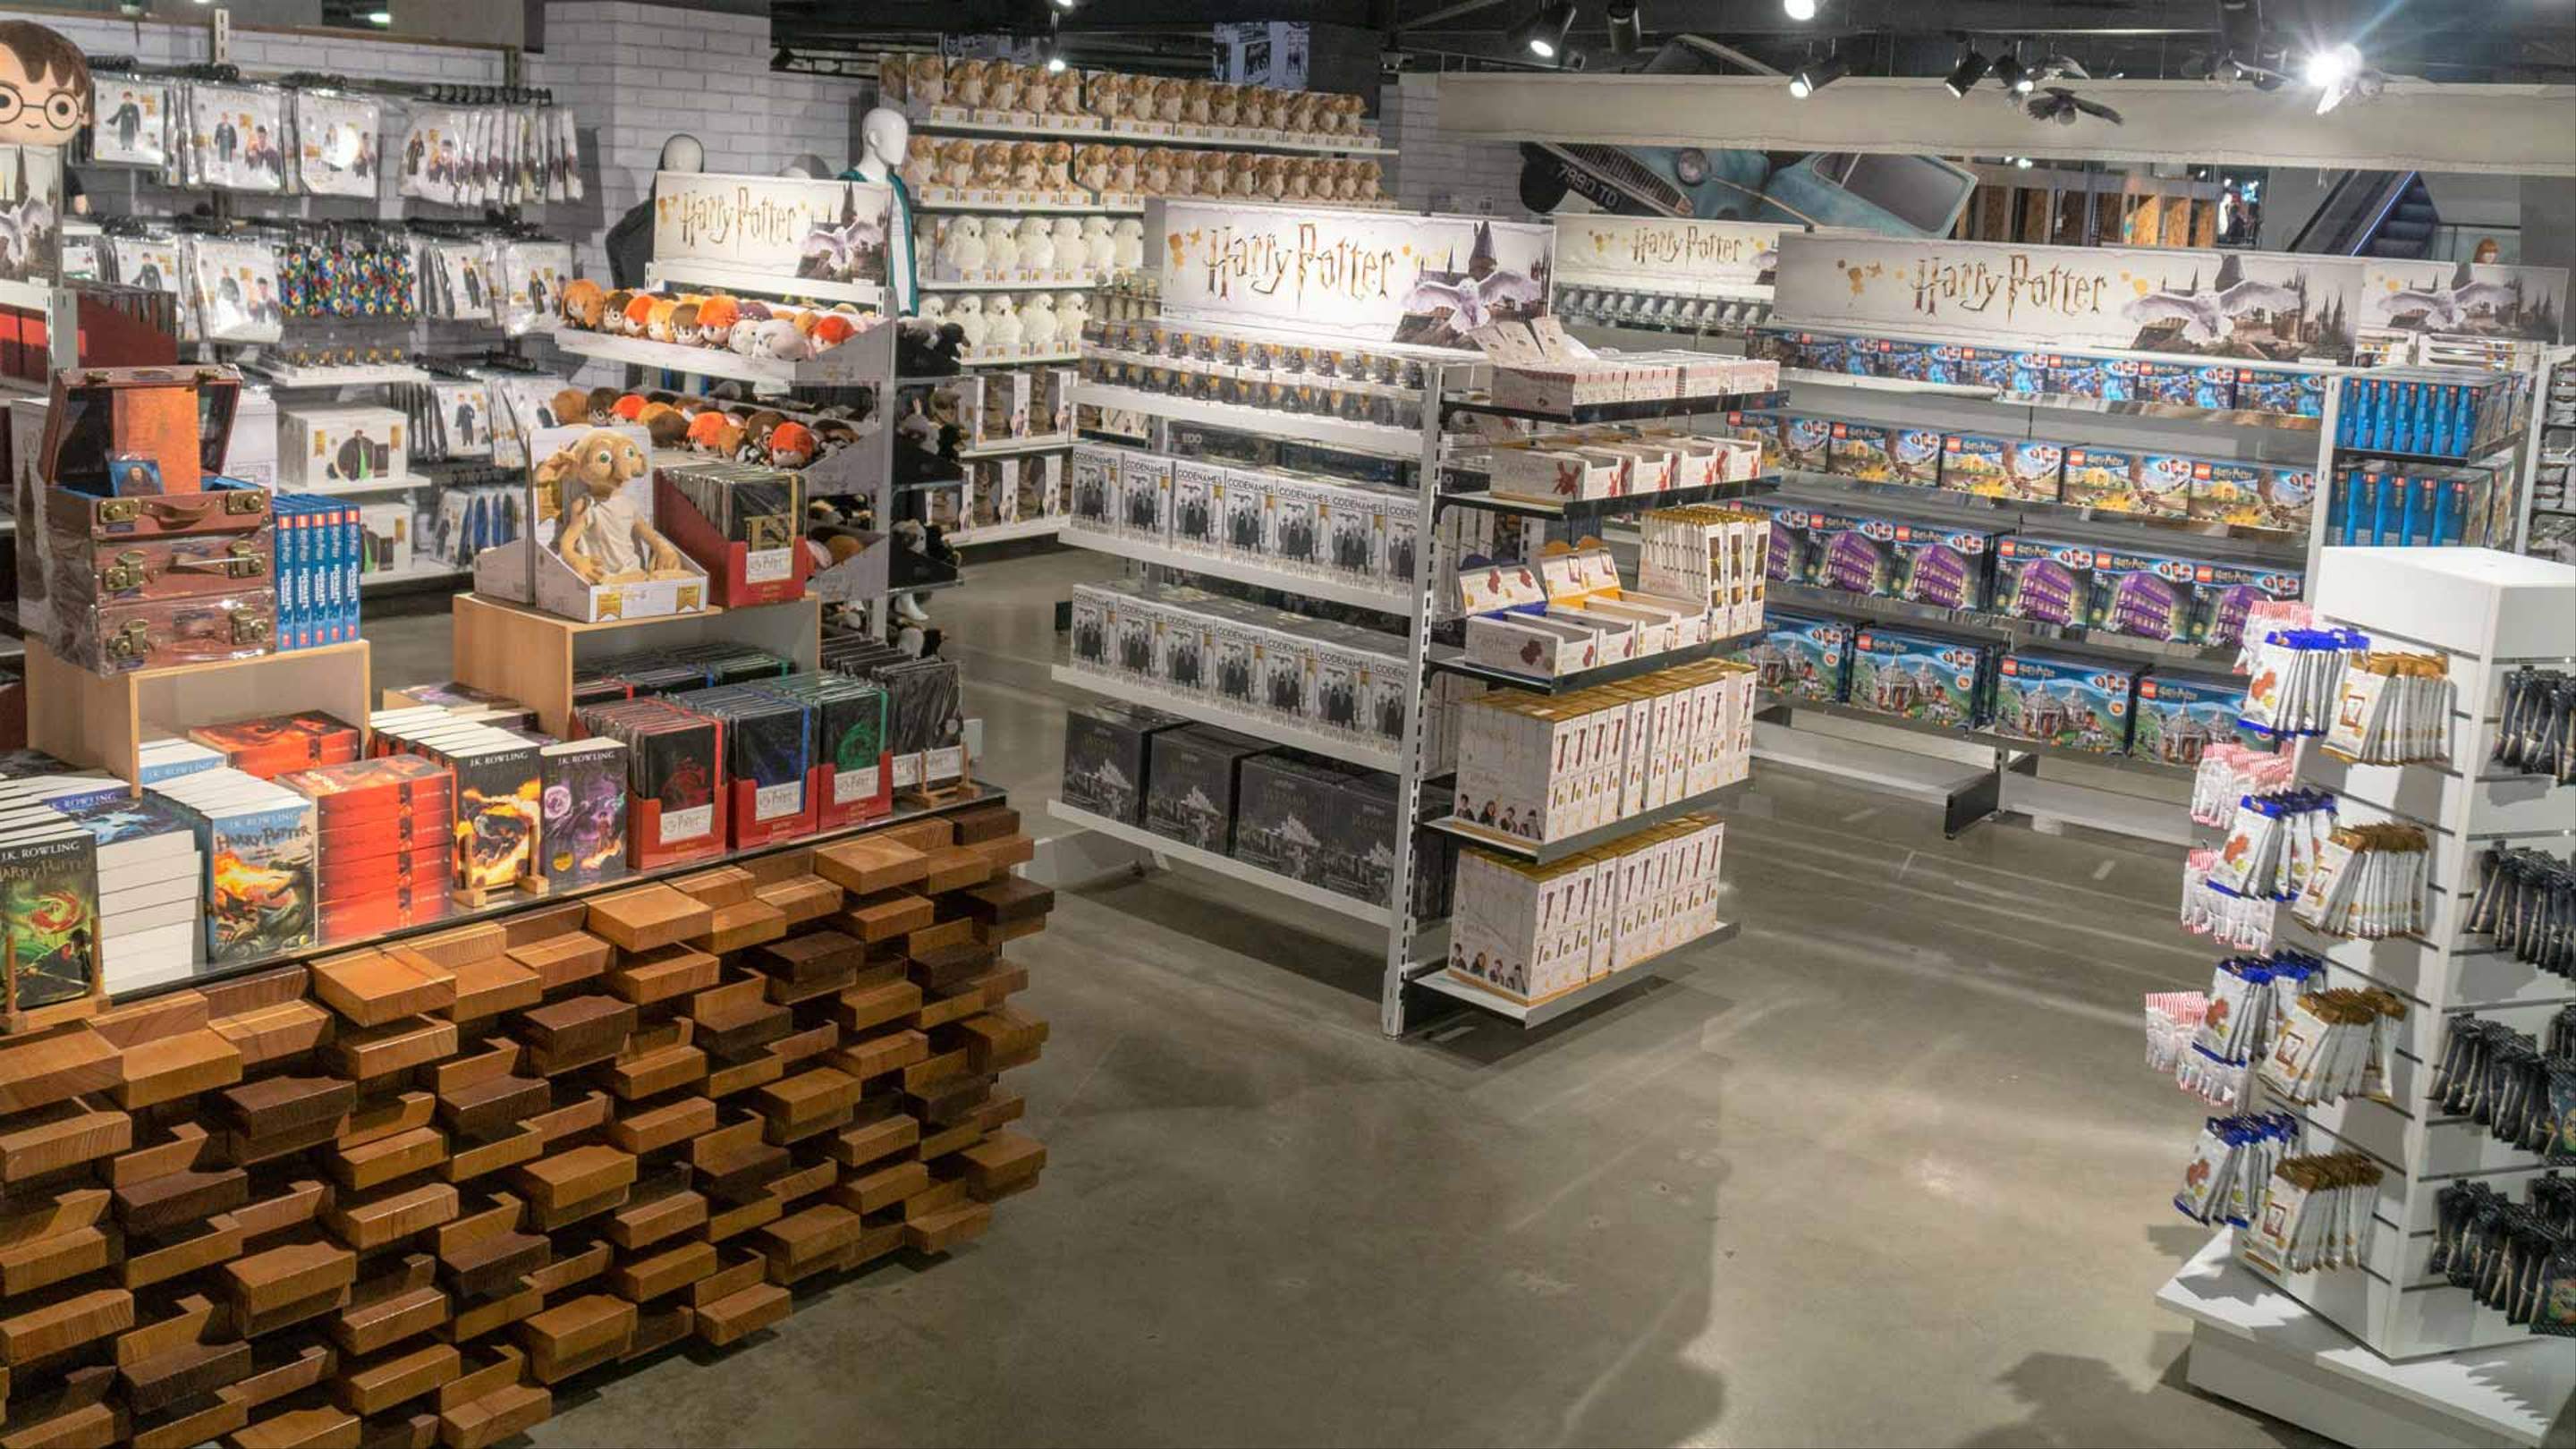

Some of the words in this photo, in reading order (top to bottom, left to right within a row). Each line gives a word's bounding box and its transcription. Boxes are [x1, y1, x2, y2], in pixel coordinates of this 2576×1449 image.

[678, 190, 734, 249] Harry
[736, 186, 796, 258] Potter
[1631, 228, 1685, 263] Harry
[1685, 225, 1742, 267] Potter
[1203, 225, 1293, 301] Harry
[1298, 223, 1394, 309] Potter
[1911, 256, 2004, 317] Harry
[2007, 254, 2107, 322] Potter
[1125, 460, 1169, 475] CODENAMES
[1178, 469, 1223, 485] CODENAMES
[1227, 478, 1275, 495] CODENAMES
[1279, 486, 1329, 504] CODENAMES
[1333, 496, 1384, 513] CODENAMES
[486, 752, 529, 765] ROWLING
[572, 751, 615, 763] ROWLING
[64, 792, 115, 809] ROWLING
[216, 832, 263, 852] HARRY
[262, 826, 311, 844] POTTER
[21, 840, 80, 859] ROWLING
